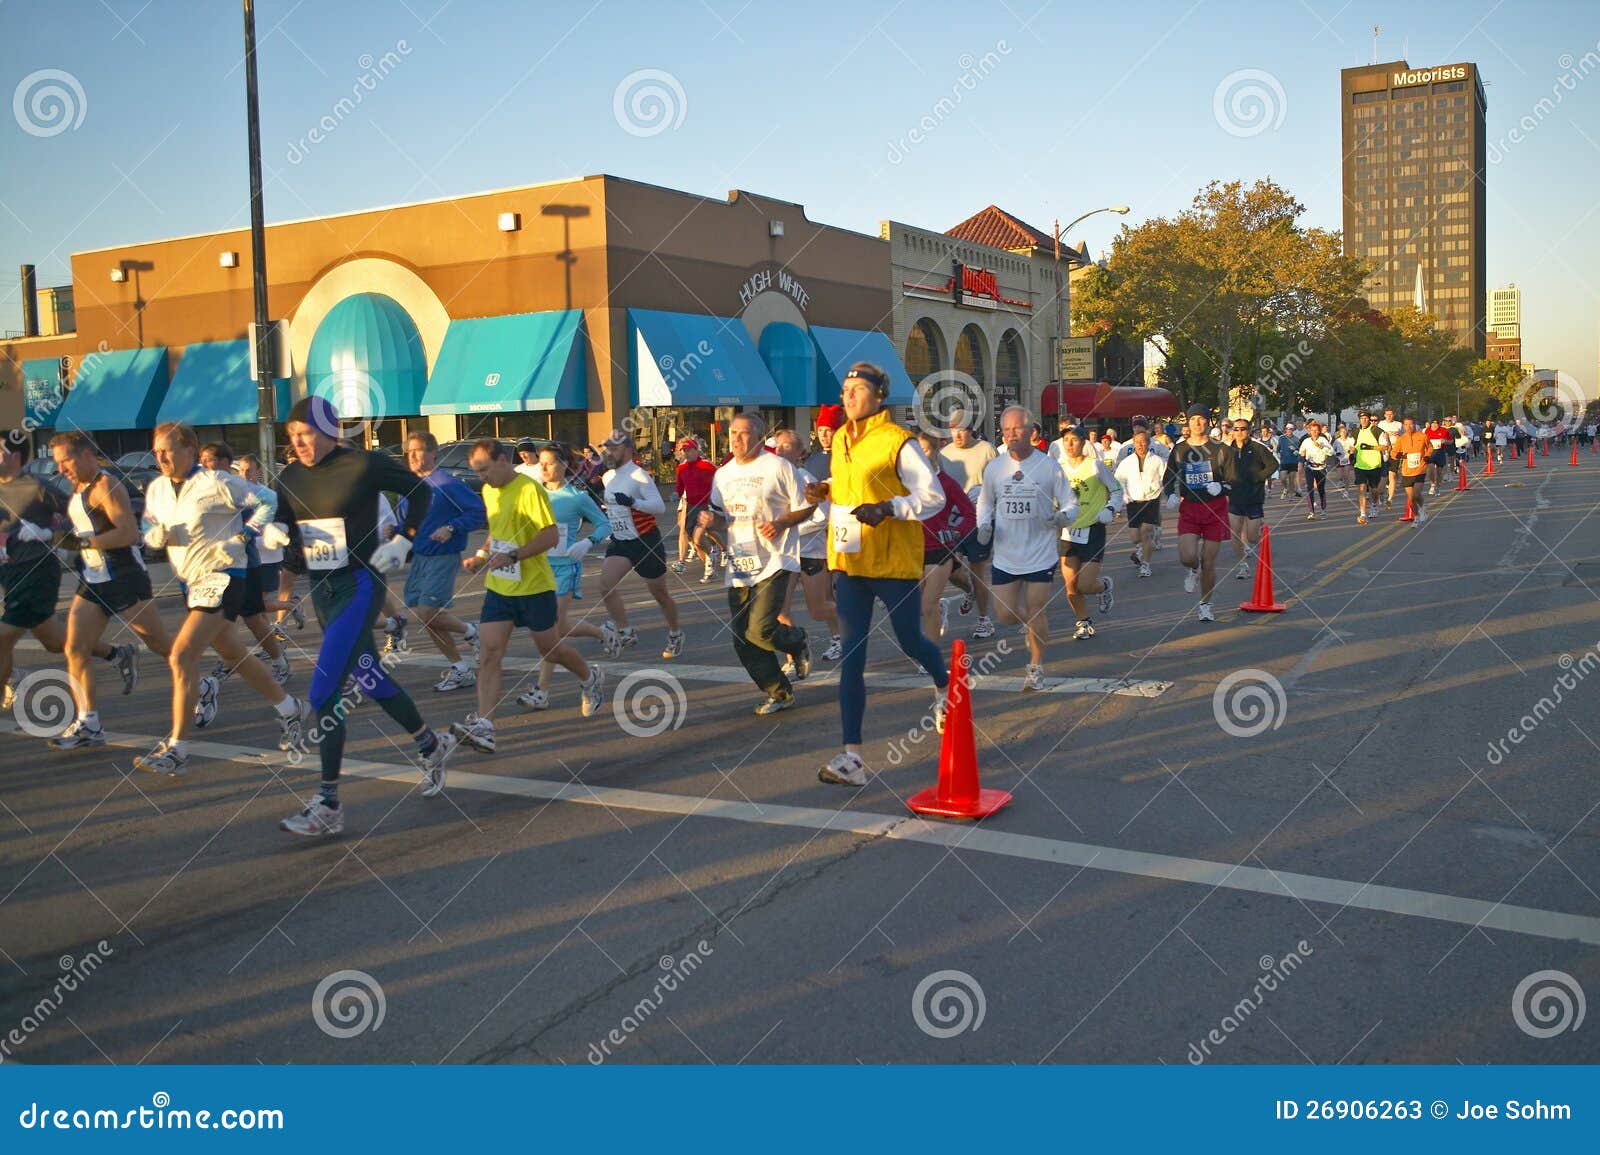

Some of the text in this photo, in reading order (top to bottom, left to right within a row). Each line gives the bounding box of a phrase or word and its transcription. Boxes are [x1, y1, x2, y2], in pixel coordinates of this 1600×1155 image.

[1394, 67, 1465, 85] Motorists
[739, 270, 810, 311] HUGH WHITE
[468, 403, 503, 412] HONDA
[1006, 501, 1031, 514] 7334
[308, 544, 339, 562] 7391
